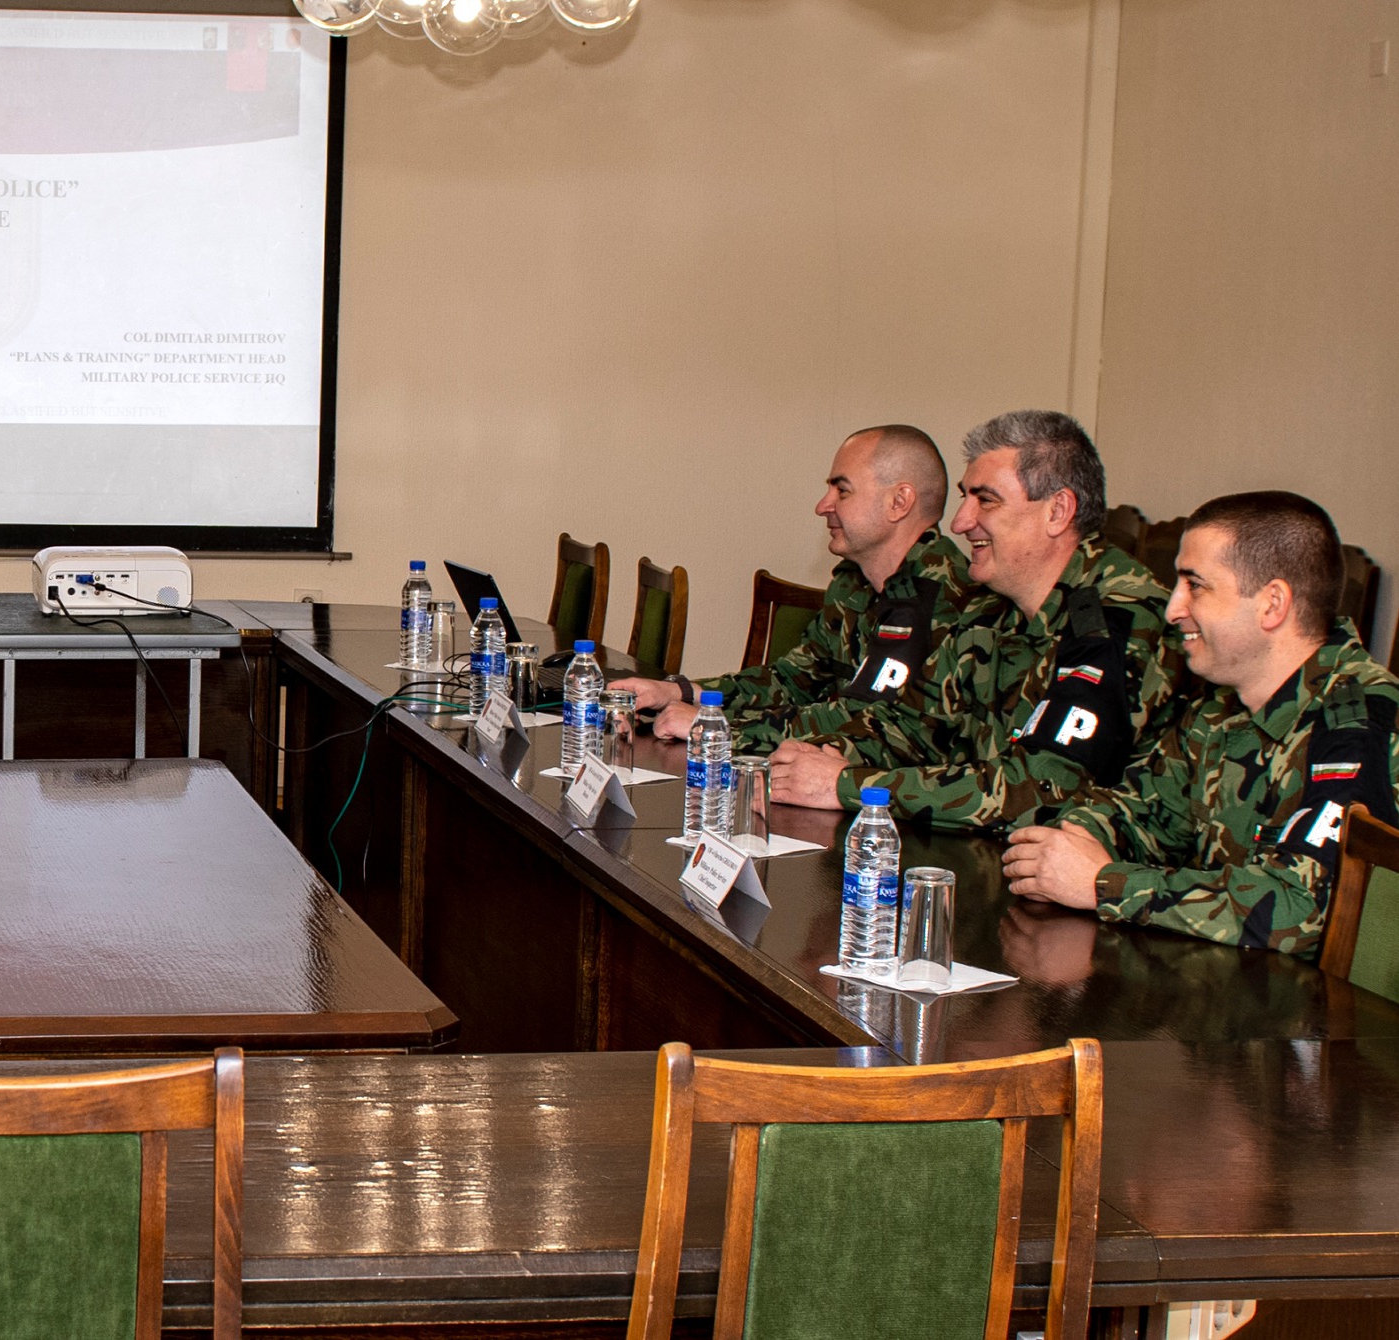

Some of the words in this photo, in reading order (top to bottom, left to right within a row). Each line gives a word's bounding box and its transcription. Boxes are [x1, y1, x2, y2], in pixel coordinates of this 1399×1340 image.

[122, 332, 152, 343] COL
[154, 332, 213, 344] DIMITAR
[216, 332, 287, 344] DIMITROV
[62, 352, 74, 363] &
[153, 352, 245, 364] DEPARTMENT
[247, 353, 286, 364] HEAD
[81, 371, 148, 383] MILITARY
[150, 372, 202, 384] POLICE
[204, 372, 261, 384] SERVICE
